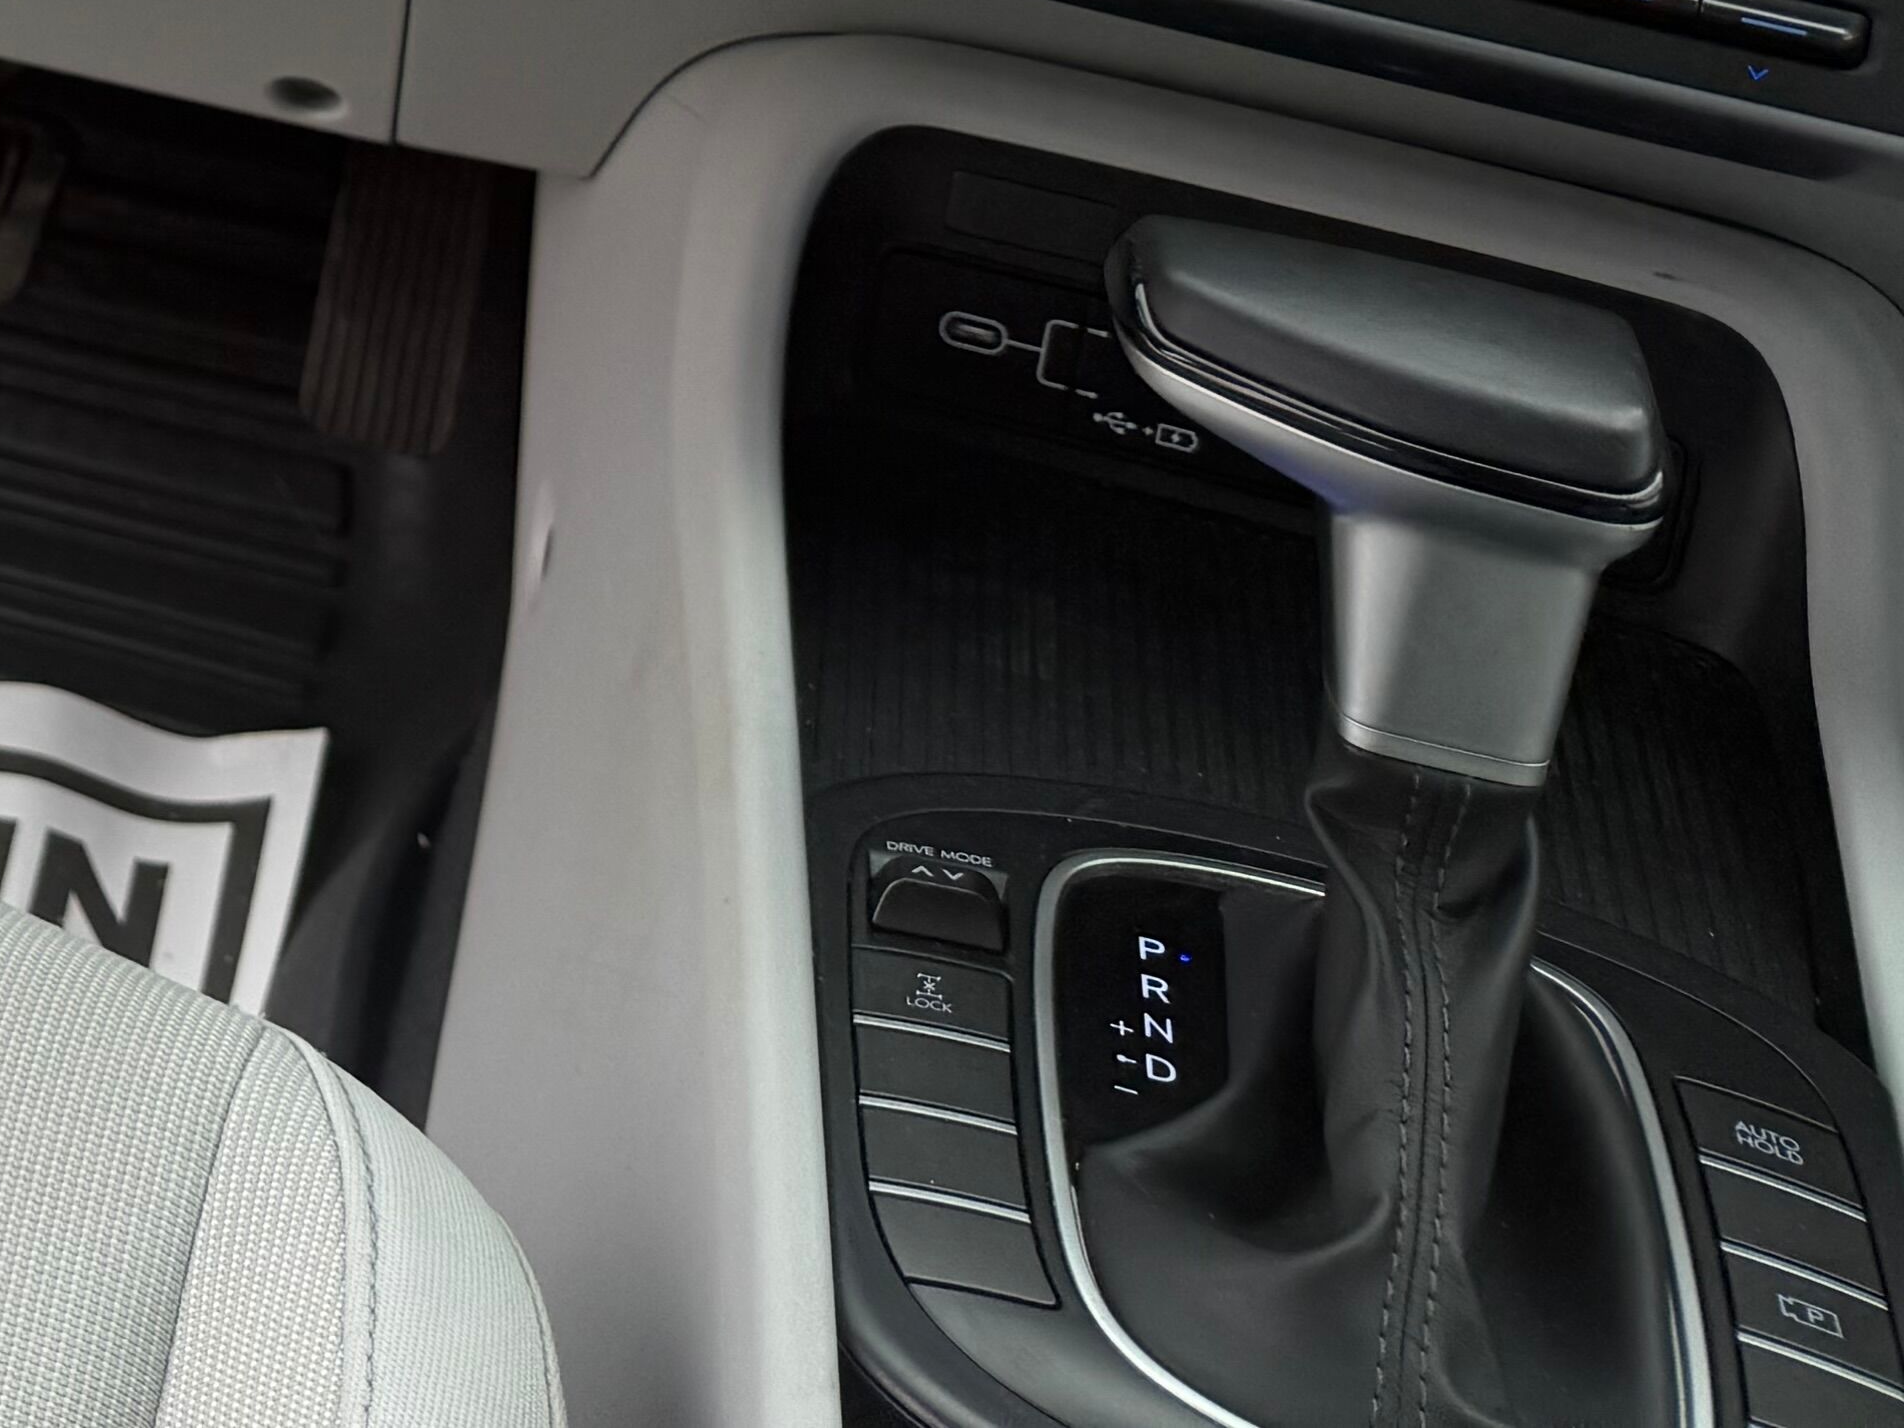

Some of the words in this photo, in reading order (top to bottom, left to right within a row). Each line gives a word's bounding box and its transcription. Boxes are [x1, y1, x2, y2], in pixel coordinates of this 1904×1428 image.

[886, 840, 934, 858] DRIVE
[939, 849, 993, 868] MODE
[1138, 936, 1166, 960] P
[1141, 973, 1170, 1004] R
[905, 996, 952, 1013] LOCK
[1144, 1014, 1174, 1044] N
[1146, 1053, 1176, 1084] D
[1735, 1121, 1800, 1152] AUTO
[1737, 1132, 1804, 1165] HOLD
